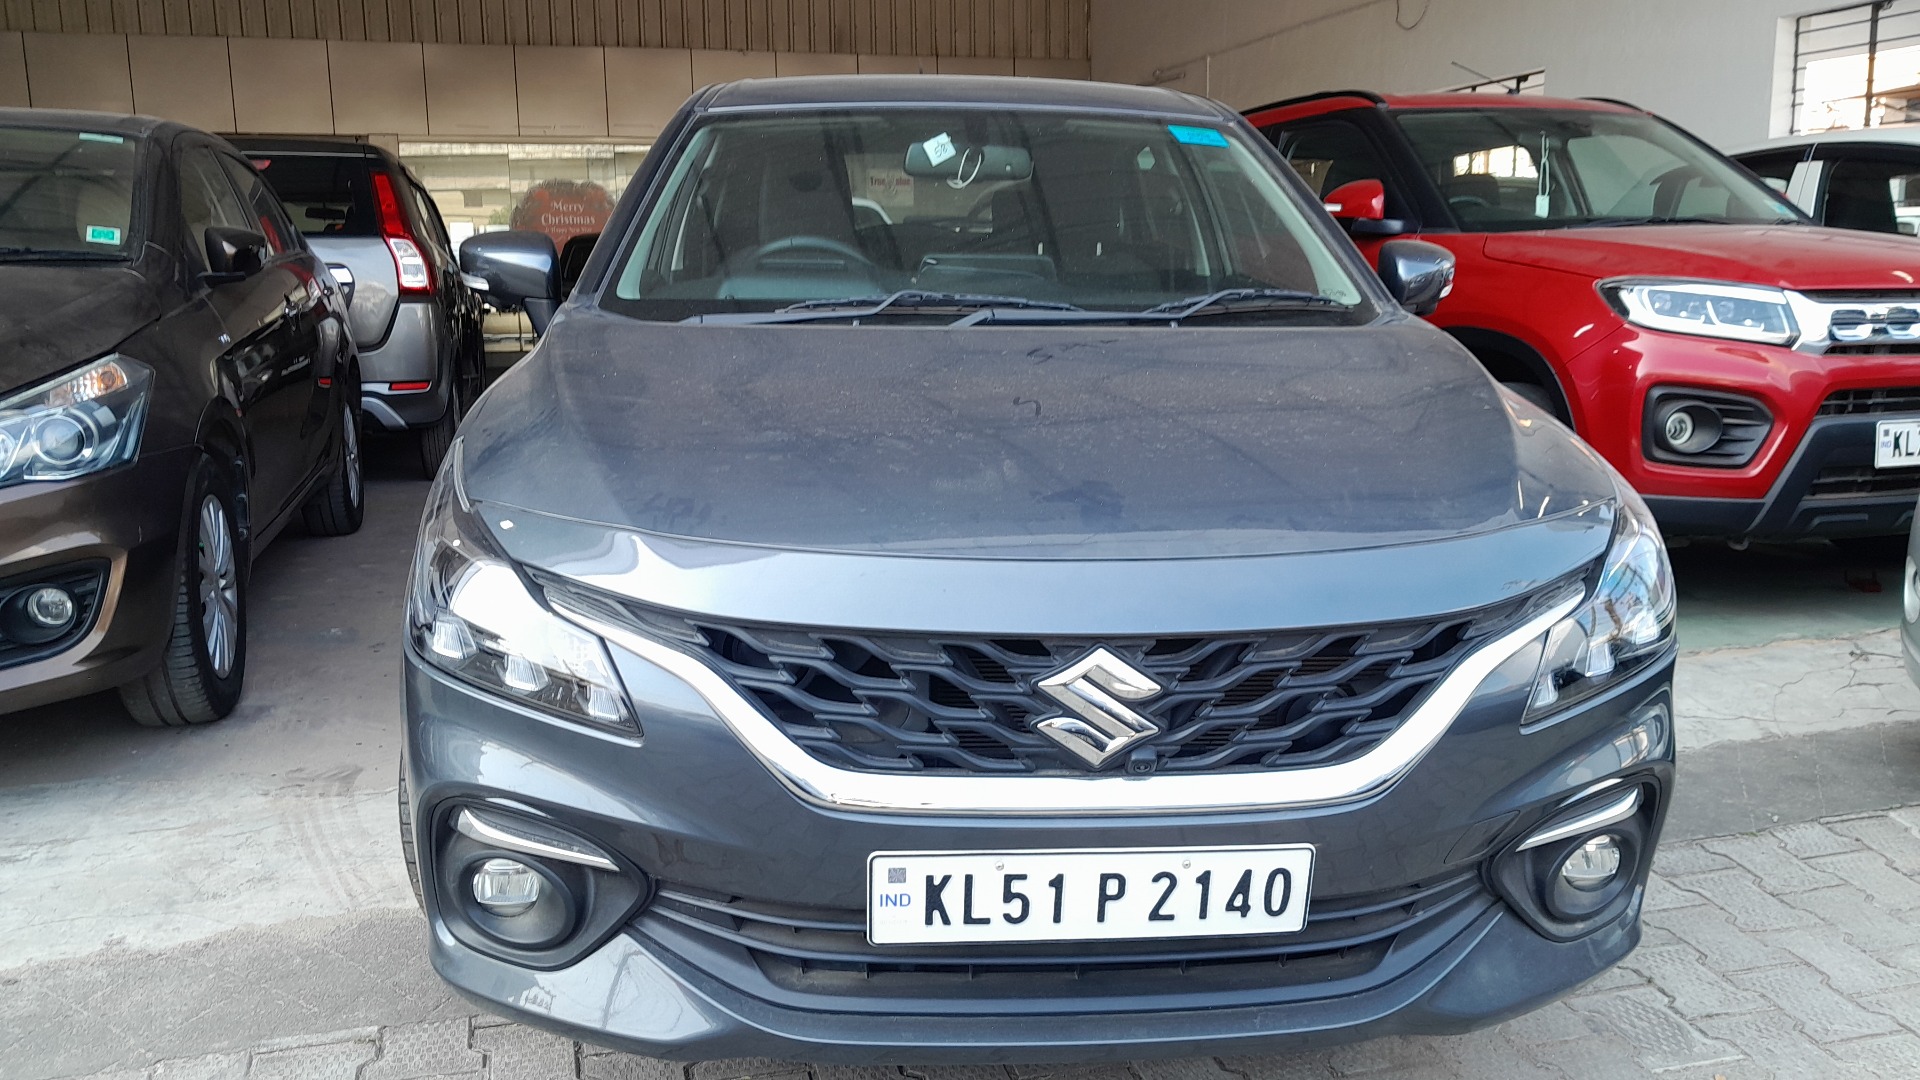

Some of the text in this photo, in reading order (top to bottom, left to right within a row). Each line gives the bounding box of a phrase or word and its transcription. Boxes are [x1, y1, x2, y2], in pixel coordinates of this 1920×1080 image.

[551, 200, 584, 213] Merry
[541, 213, 596, 226] Christmas
[879, 893, 911, 907] IND
[924, 867, 1292, 926] KL51 P 2140
